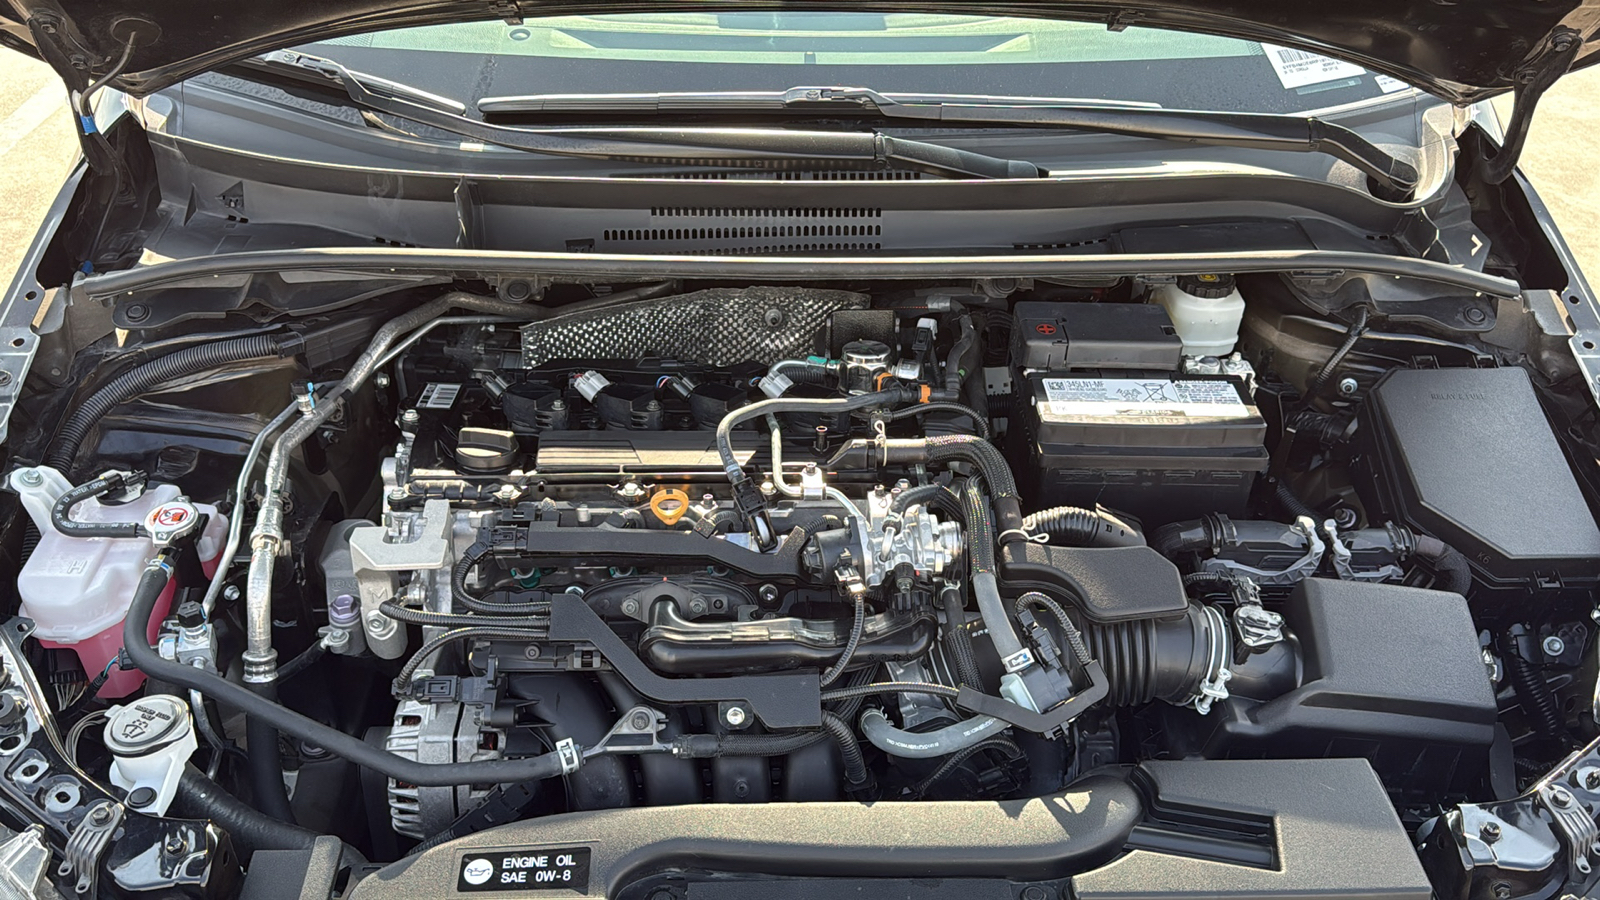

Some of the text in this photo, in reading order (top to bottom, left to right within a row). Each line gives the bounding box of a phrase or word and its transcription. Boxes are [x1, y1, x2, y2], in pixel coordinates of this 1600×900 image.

[502, 854, 576, 869] ENGINE OIL
[500, 869, 571, 883] SAE 0W-8
